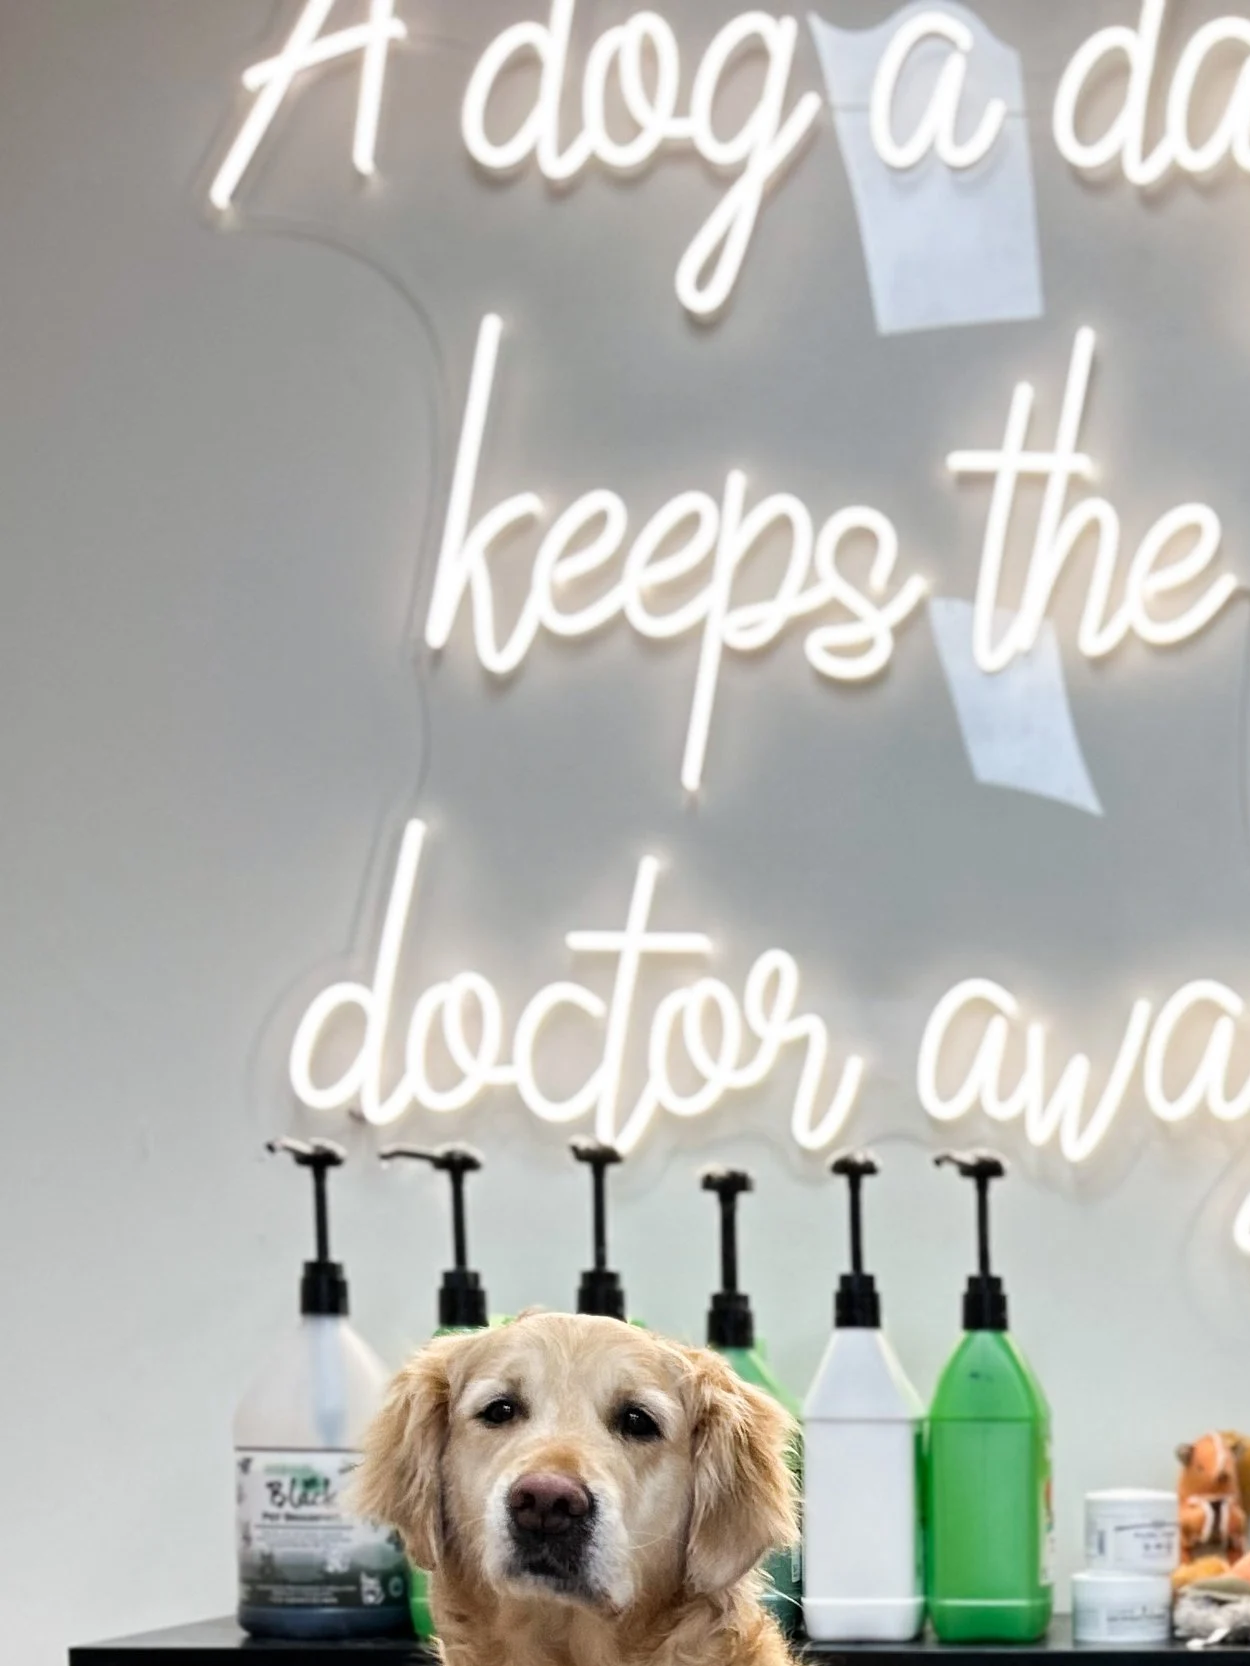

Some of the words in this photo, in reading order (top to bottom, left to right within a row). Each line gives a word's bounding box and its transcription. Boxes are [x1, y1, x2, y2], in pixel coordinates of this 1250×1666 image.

[211, 0, 406, 207] A
[462, 0, 820, 314] dog
[869, 11, 1008, 168] a
[426, 313, 928, 790] keeps
[946, 326, 1237, 672] the
[289, 819, 864, 1153] doctor
